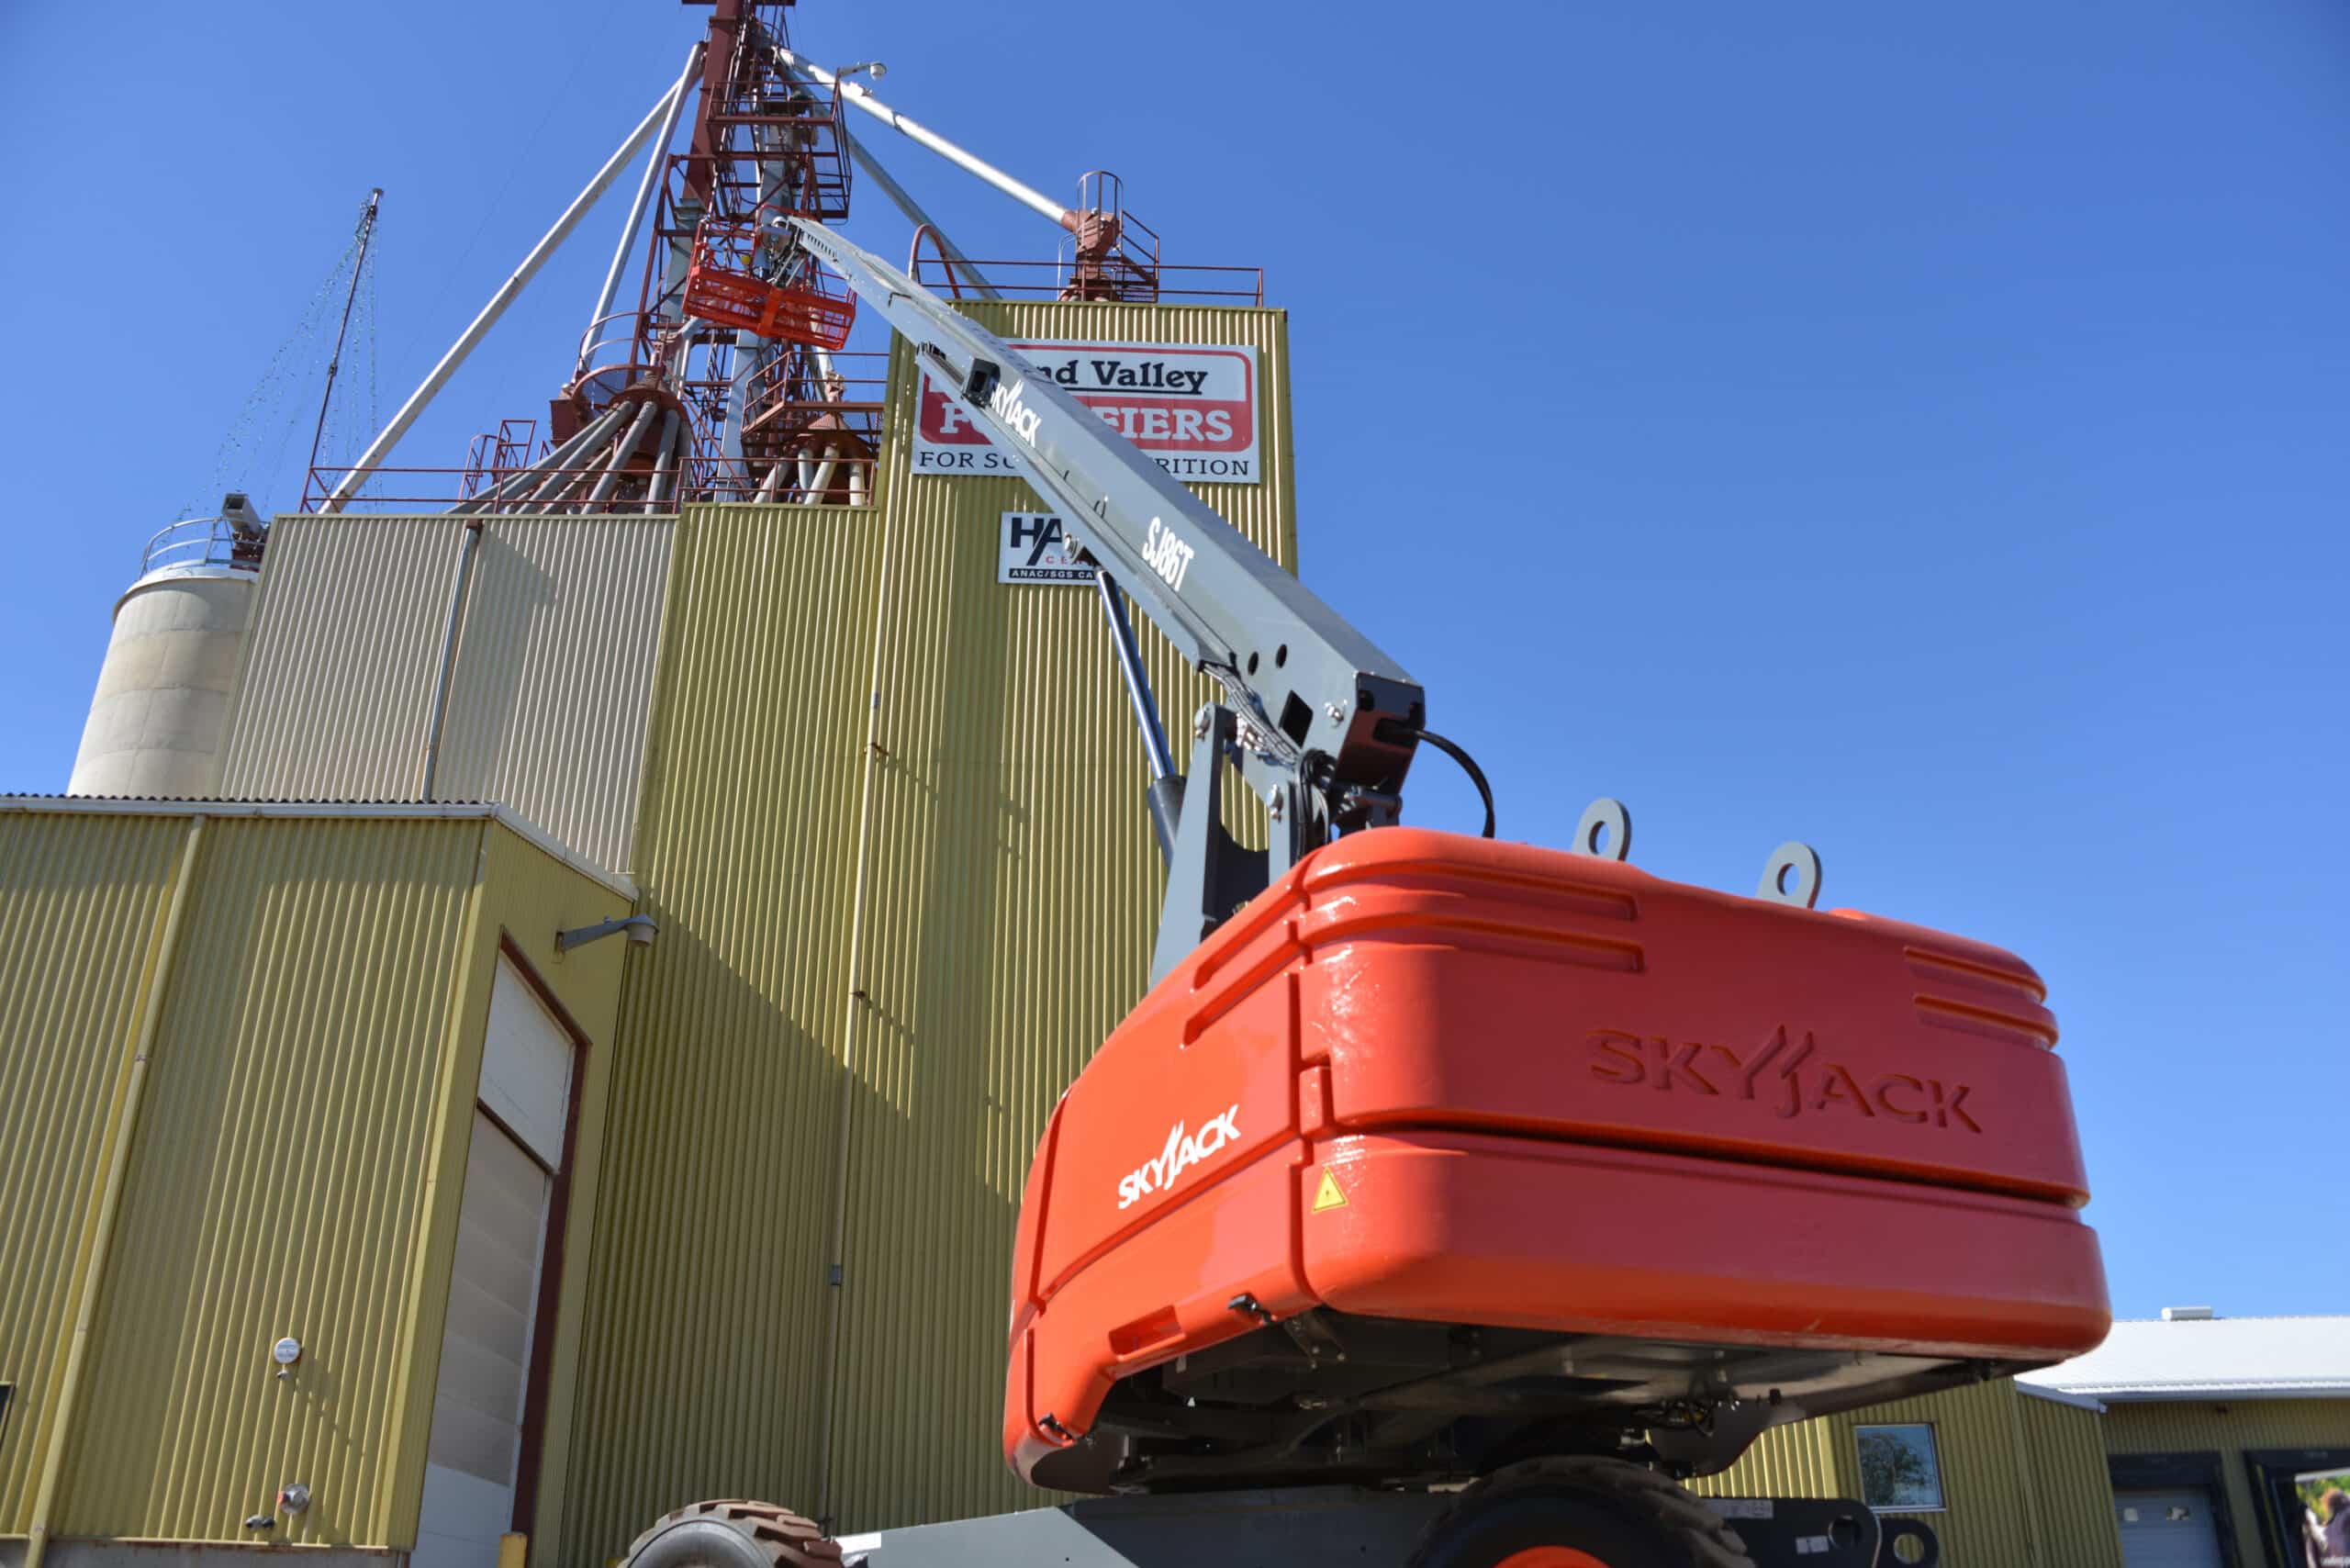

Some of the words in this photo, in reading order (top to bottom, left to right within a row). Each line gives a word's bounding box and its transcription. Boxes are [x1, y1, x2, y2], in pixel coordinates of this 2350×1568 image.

[990, 380, 1042, 448] KYJACK
[1091, 361, 1208, 395] Valley
[919, 451, 974, 468] FOR
[1142, 516, 1194, 592] SJ86T
[1585, 1024, 1983, 1134] SKYJACK
[1118, 1104, 1241, 1209] SKYJACK
